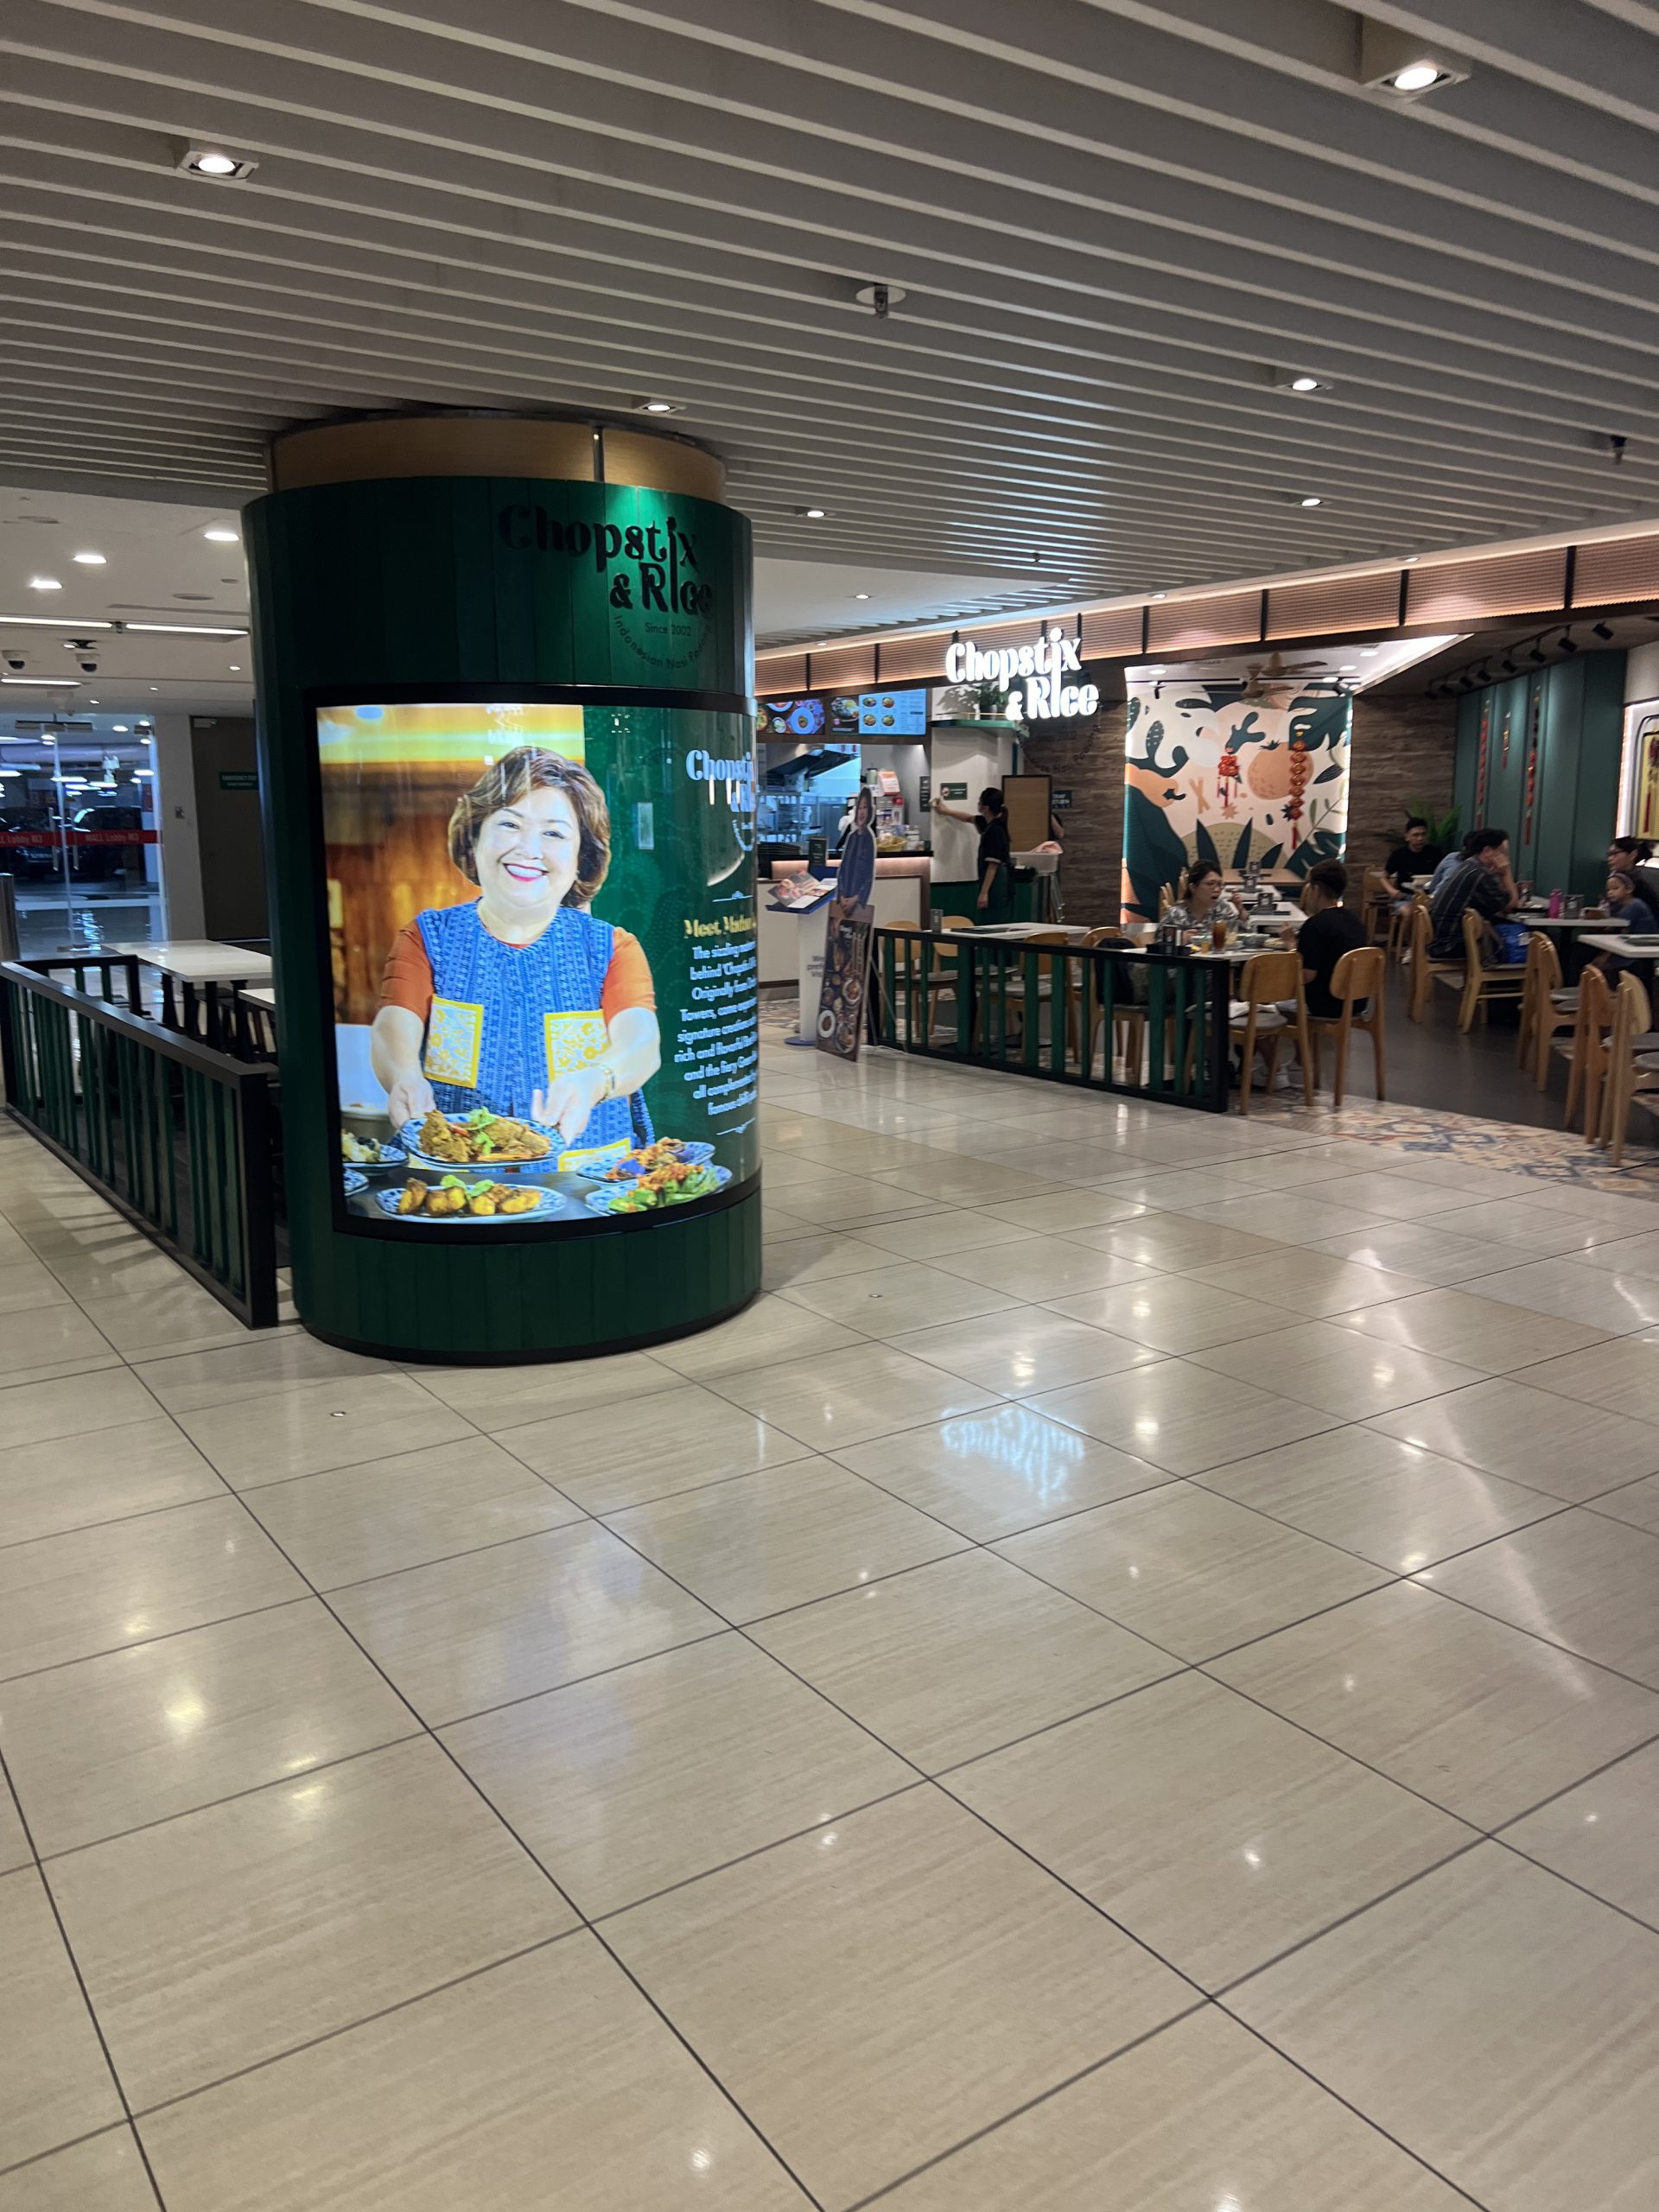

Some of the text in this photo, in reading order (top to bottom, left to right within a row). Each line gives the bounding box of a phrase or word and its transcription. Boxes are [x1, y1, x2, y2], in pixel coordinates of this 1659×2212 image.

[498, 504, 698, 573] Chopstix
[609, 562, 713, 615] & Rice
[945, 627, 1082, 692] Chopstix
[1005, 675, 1100, 721] & Rice
[692, 946, 711, 960] The
[690, 963, 722, 980] behind
[674, 1047, 696, 1063] rich
[696, 1044, 715, 1059] and
[683, 1065, 705, 1081] and
